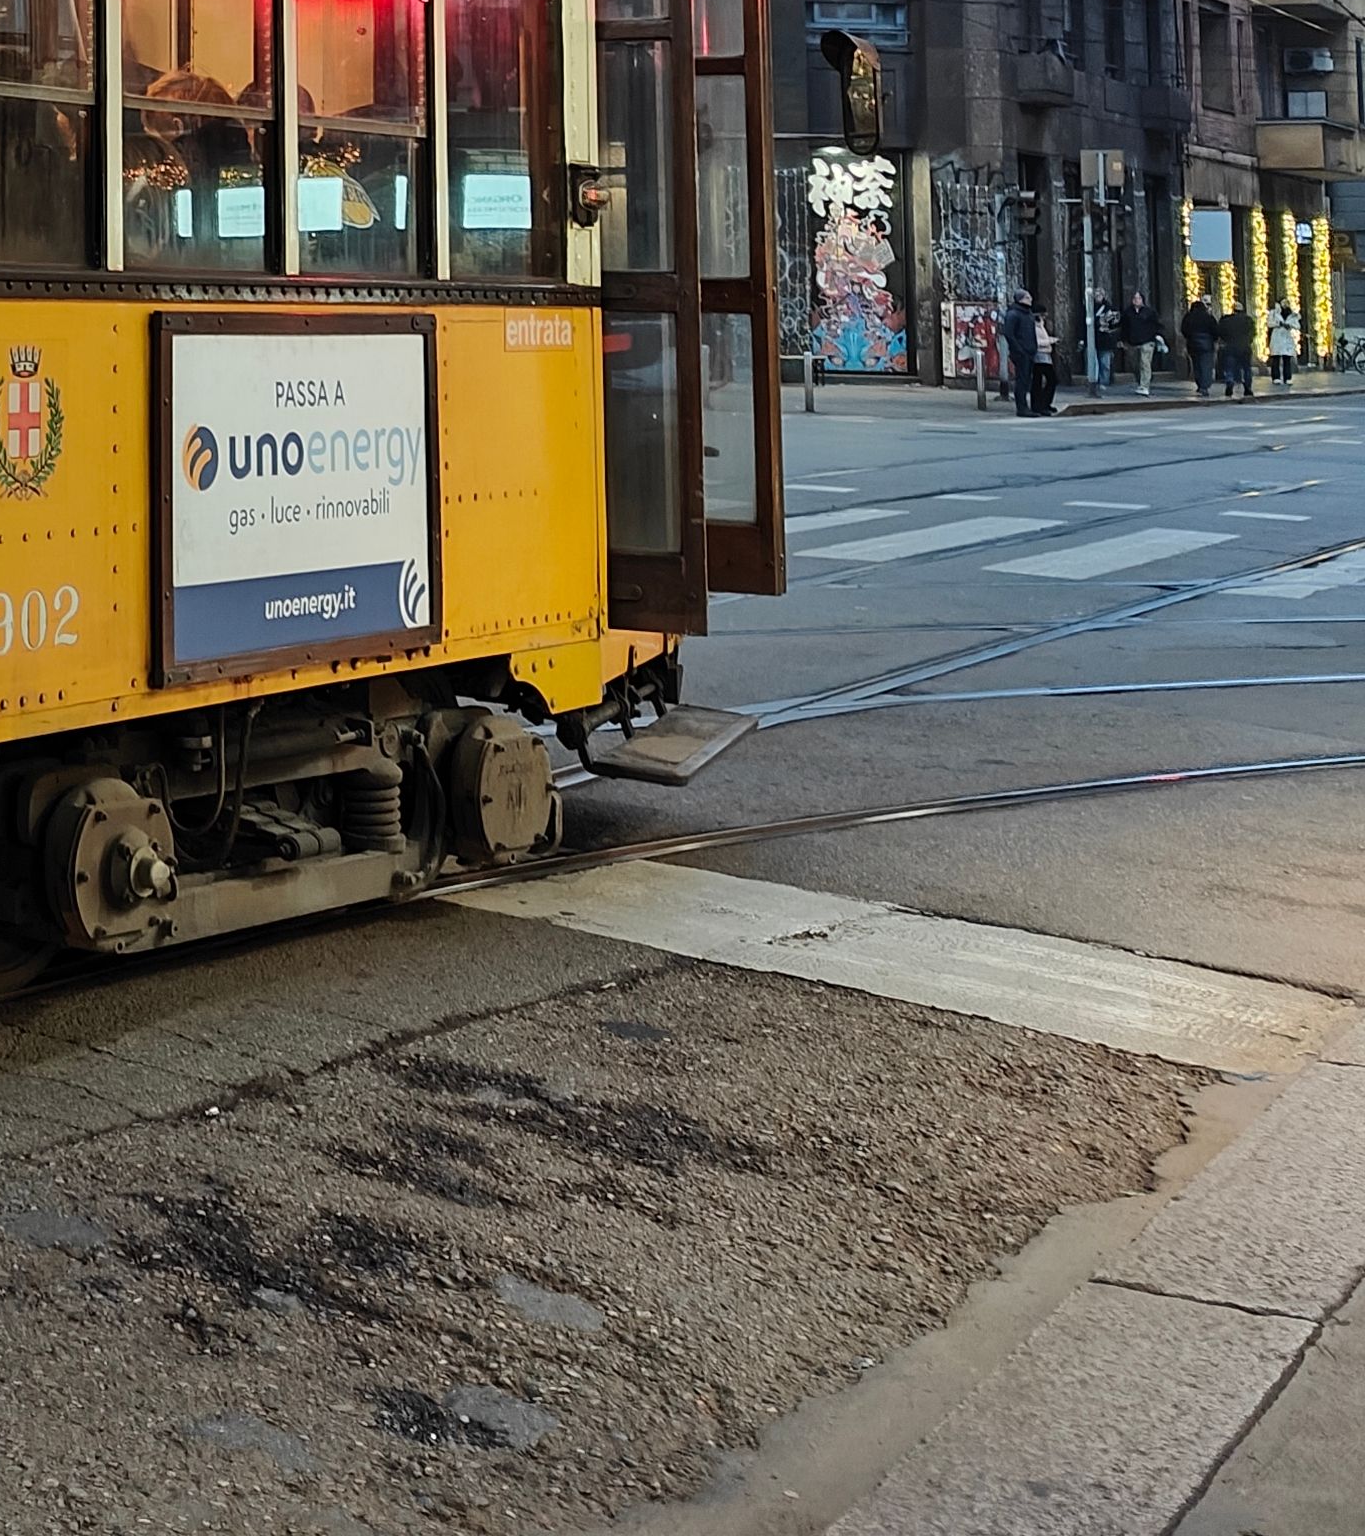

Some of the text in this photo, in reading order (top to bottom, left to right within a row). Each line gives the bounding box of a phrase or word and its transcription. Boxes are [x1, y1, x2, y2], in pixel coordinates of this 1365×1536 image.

[506, 313, 573, 346] entrata
[275, 379, 346, 408] PASSA A
[228, 425, 422, 487] unoenergy
[228, 486, 390, 536] gas luce rinnovabili
[264, 583, 356, 621] unoenergy.it
